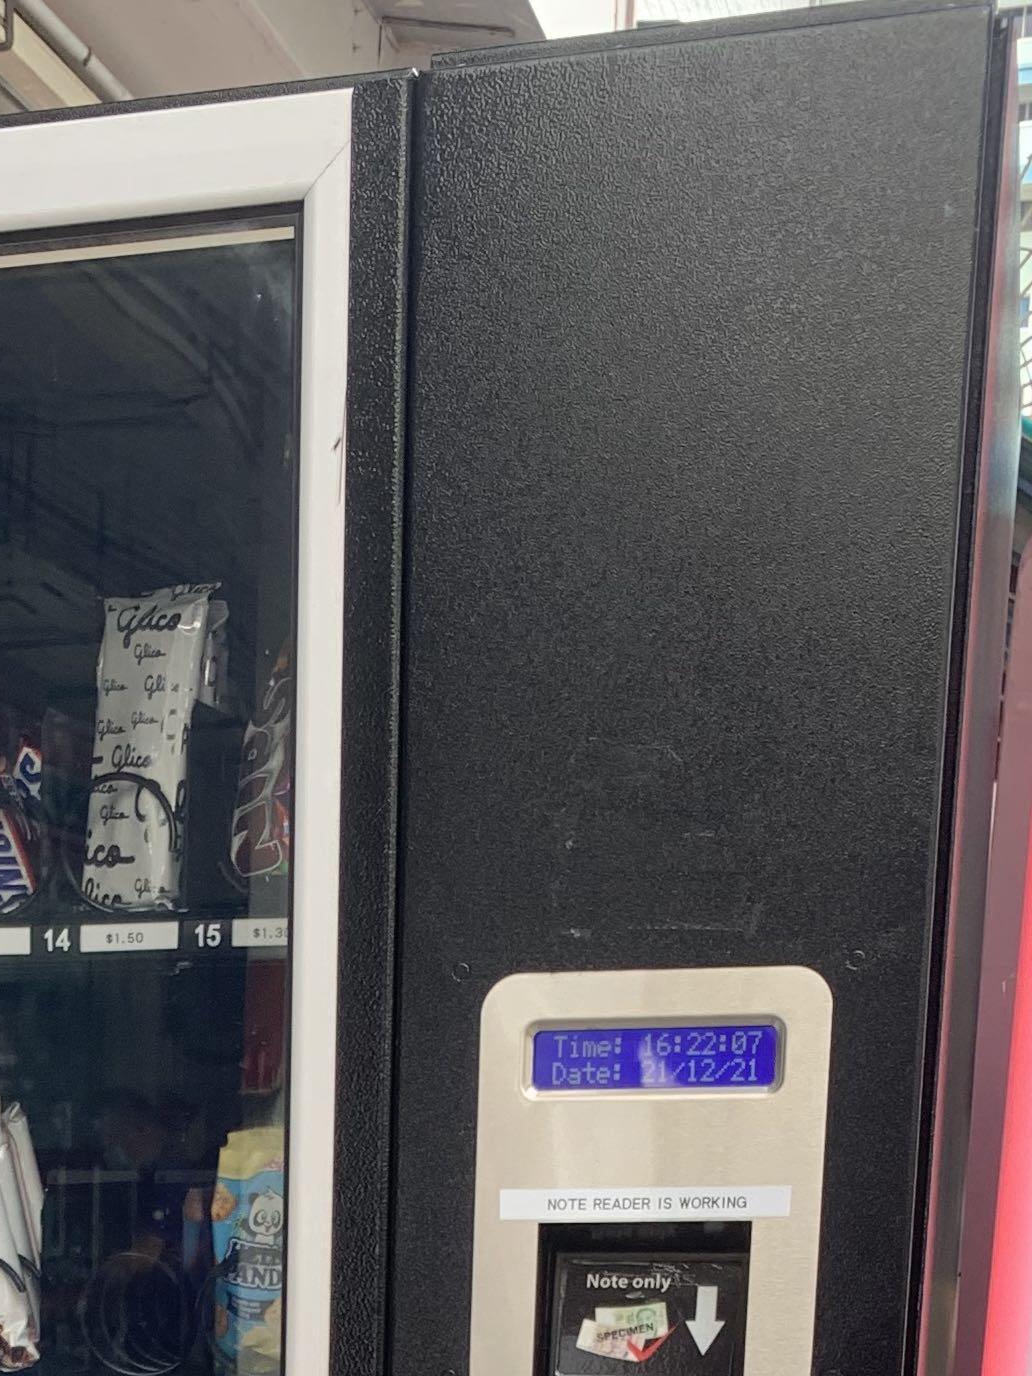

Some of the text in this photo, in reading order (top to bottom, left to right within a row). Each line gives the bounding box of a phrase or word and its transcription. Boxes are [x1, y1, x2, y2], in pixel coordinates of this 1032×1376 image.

[117, 604, 181, 649] Glico
[134, 643, 166, 666] Glico
[44, 928, 70, 952] 14
[105, 932, 144, 944] $1.50
[194, 924, 222, 947] 15
[553, 1031, 763, 1058] Time: 16:22:07
[552, 1058, 758, 1085] Date: 21/12/21
[548, 1196, 747, 1211] NOTE READER IS WORKING
[587, 1273, 672, 1293] Note only
[596, 1323, 654, 1342] SPECIMEN
